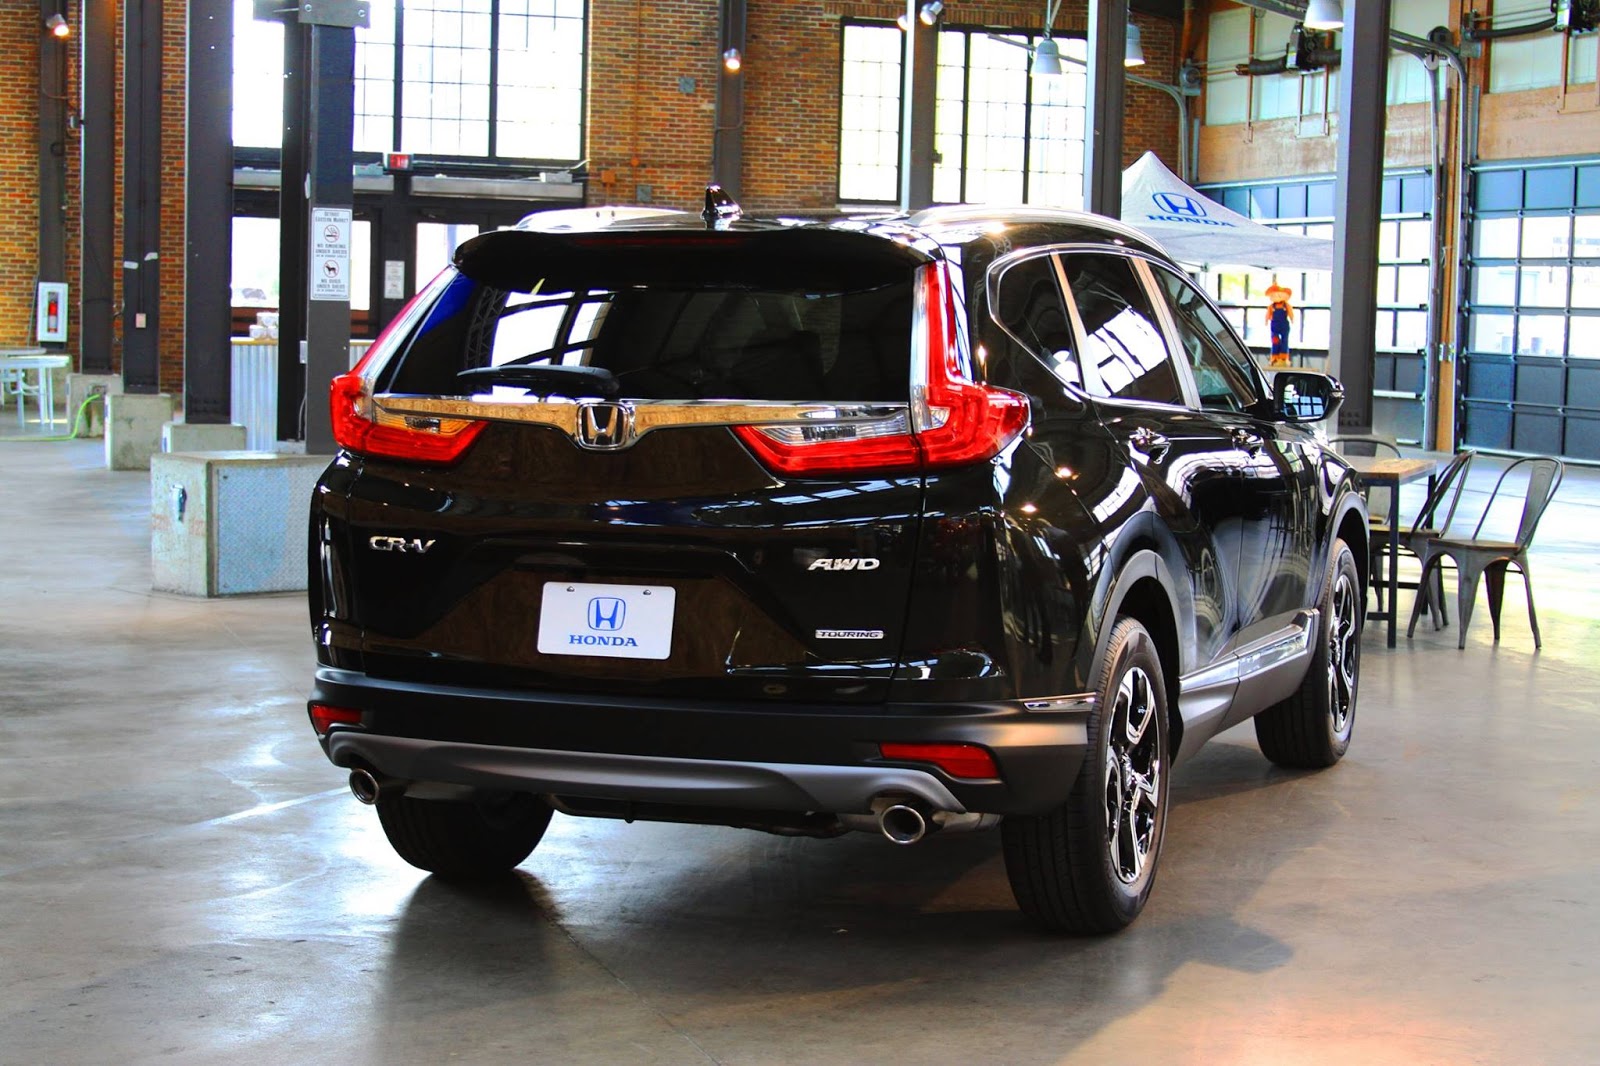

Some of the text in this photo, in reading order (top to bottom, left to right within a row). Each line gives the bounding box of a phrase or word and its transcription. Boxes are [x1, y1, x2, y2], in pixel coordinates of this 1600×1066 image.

[1146, 214, 1238, 228] HONDA
[369, 535, 437, 554] CR-V
[807, 558, 880, 571] AWD
[568, 634, 639, 647] HONDA
